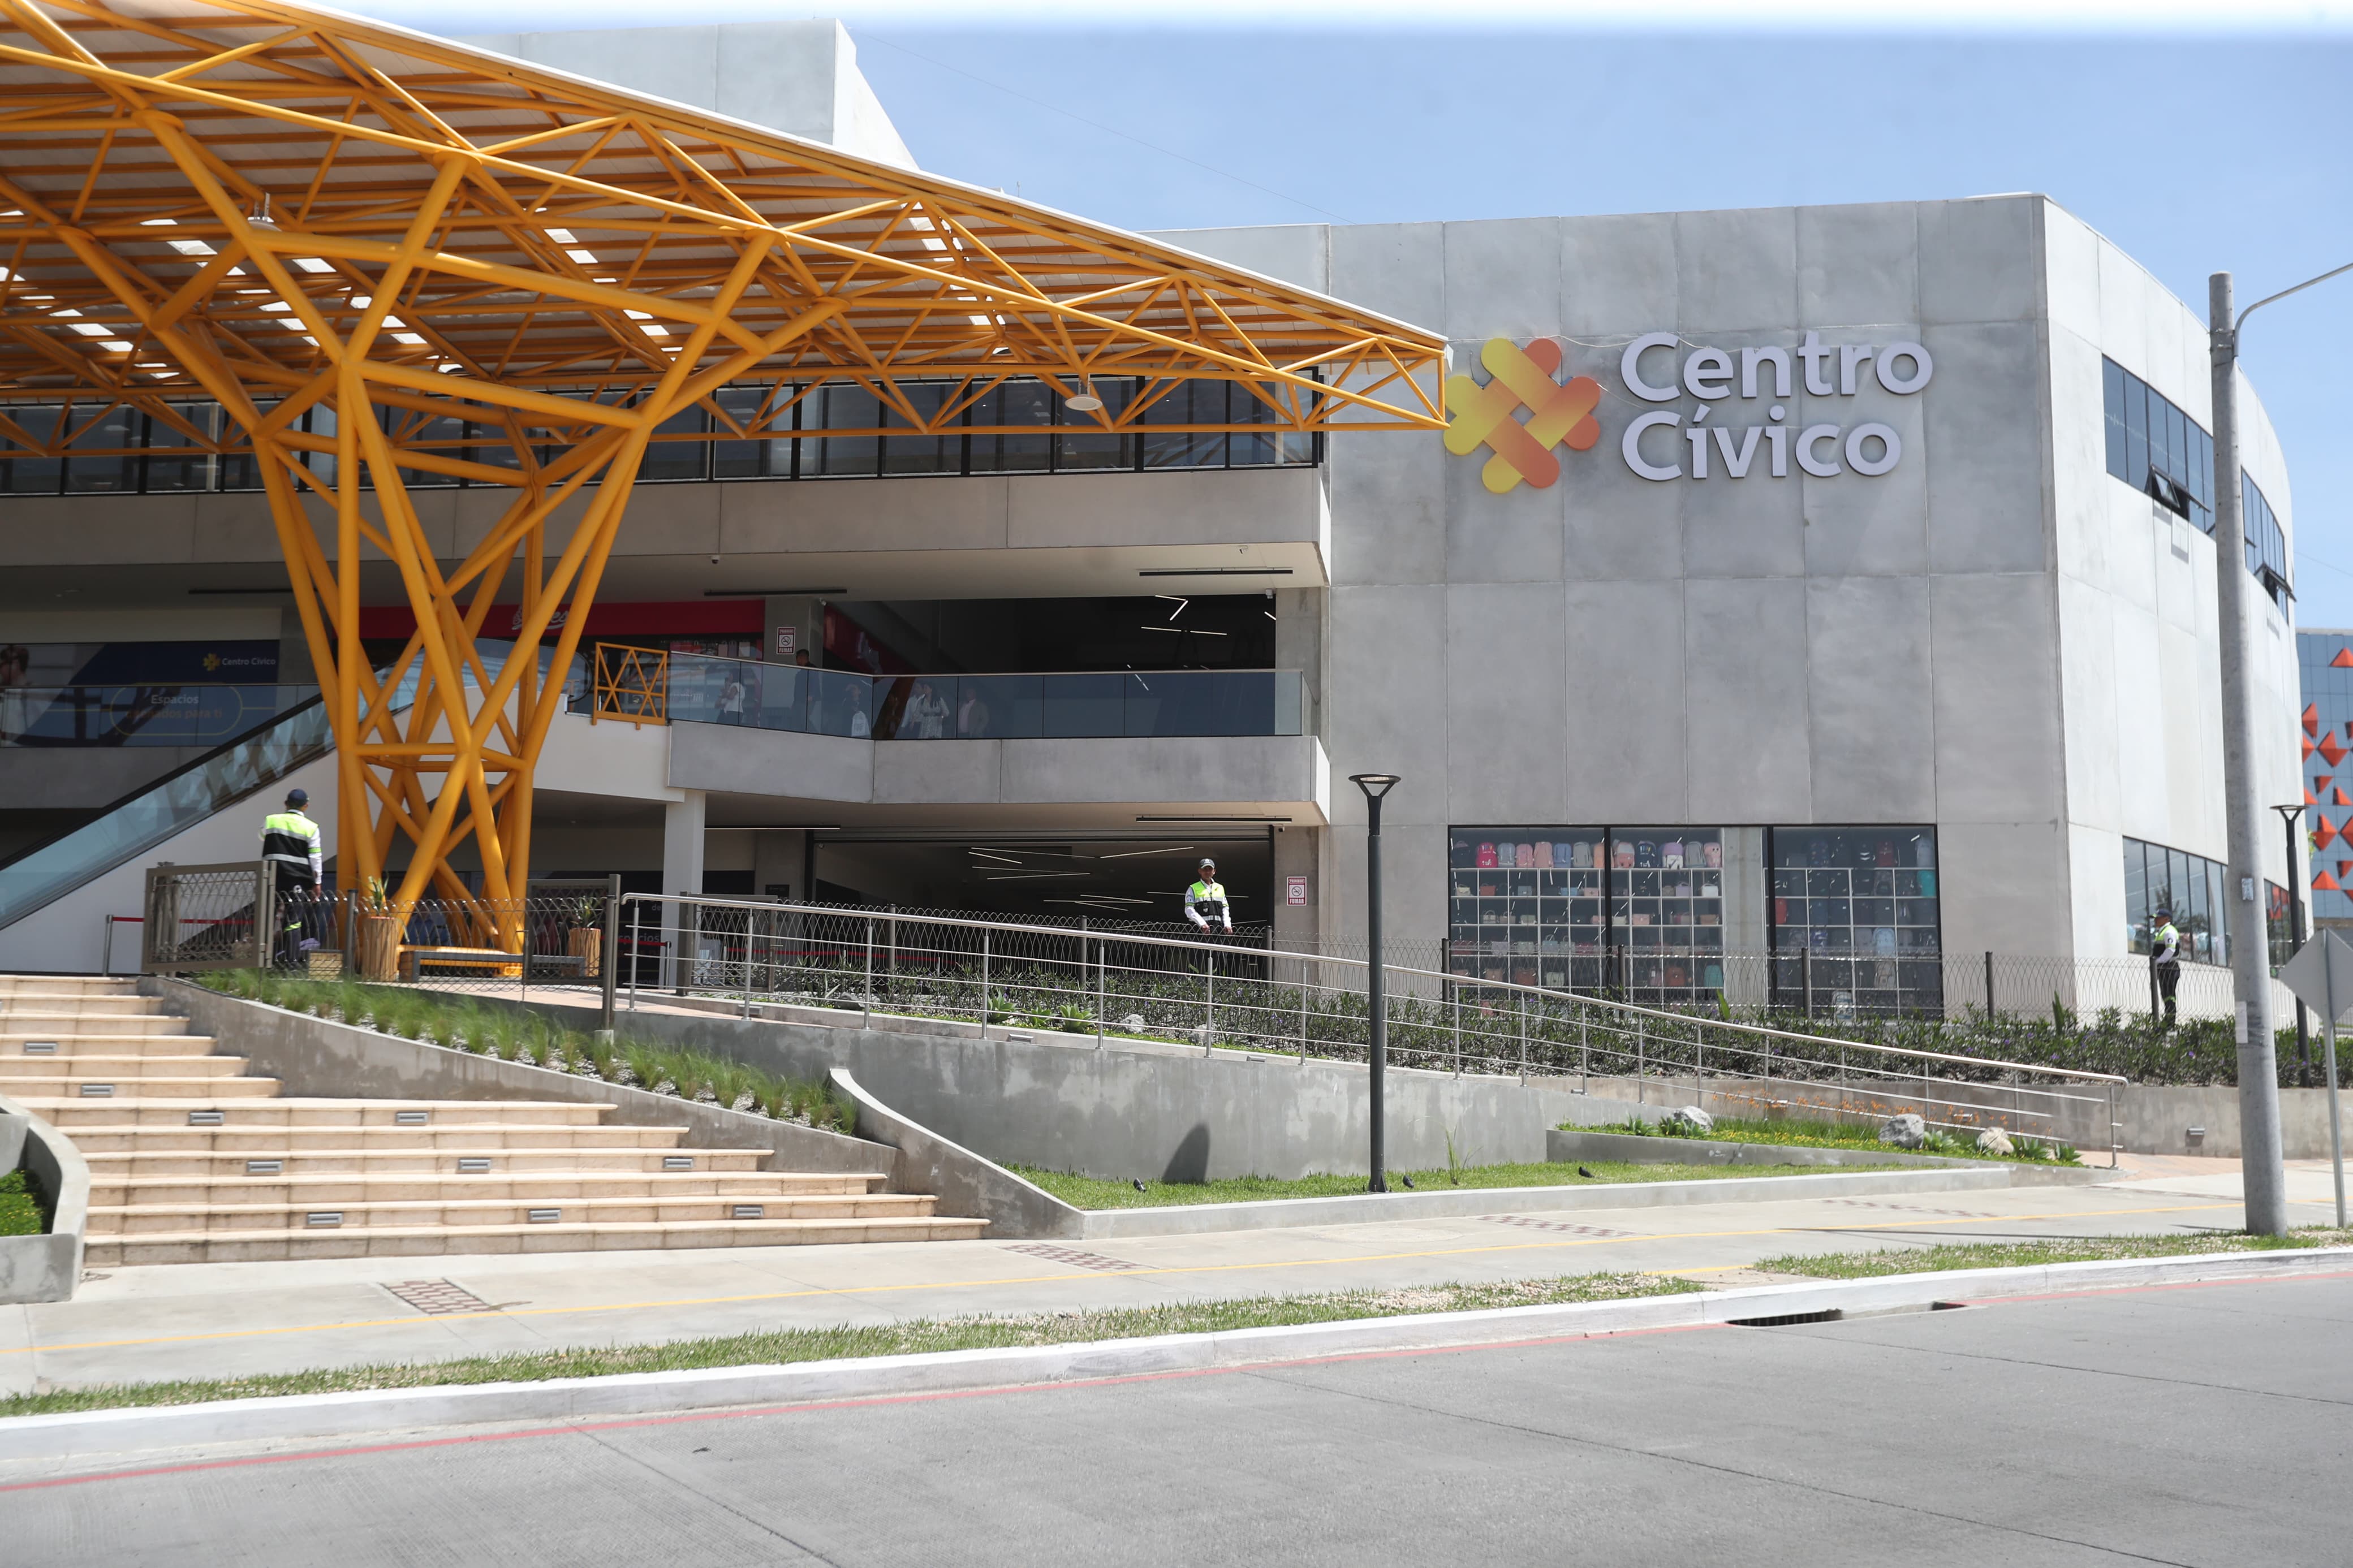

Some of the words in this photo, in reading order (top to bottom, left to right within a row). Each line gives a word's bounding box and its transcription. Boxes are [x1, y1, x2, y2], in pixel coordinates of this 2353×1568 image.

[1621, 331, 1933, 402] Centro
[1622, 403, 1902, 481] Cívico
[151, 694, 199, 705] Espacios
